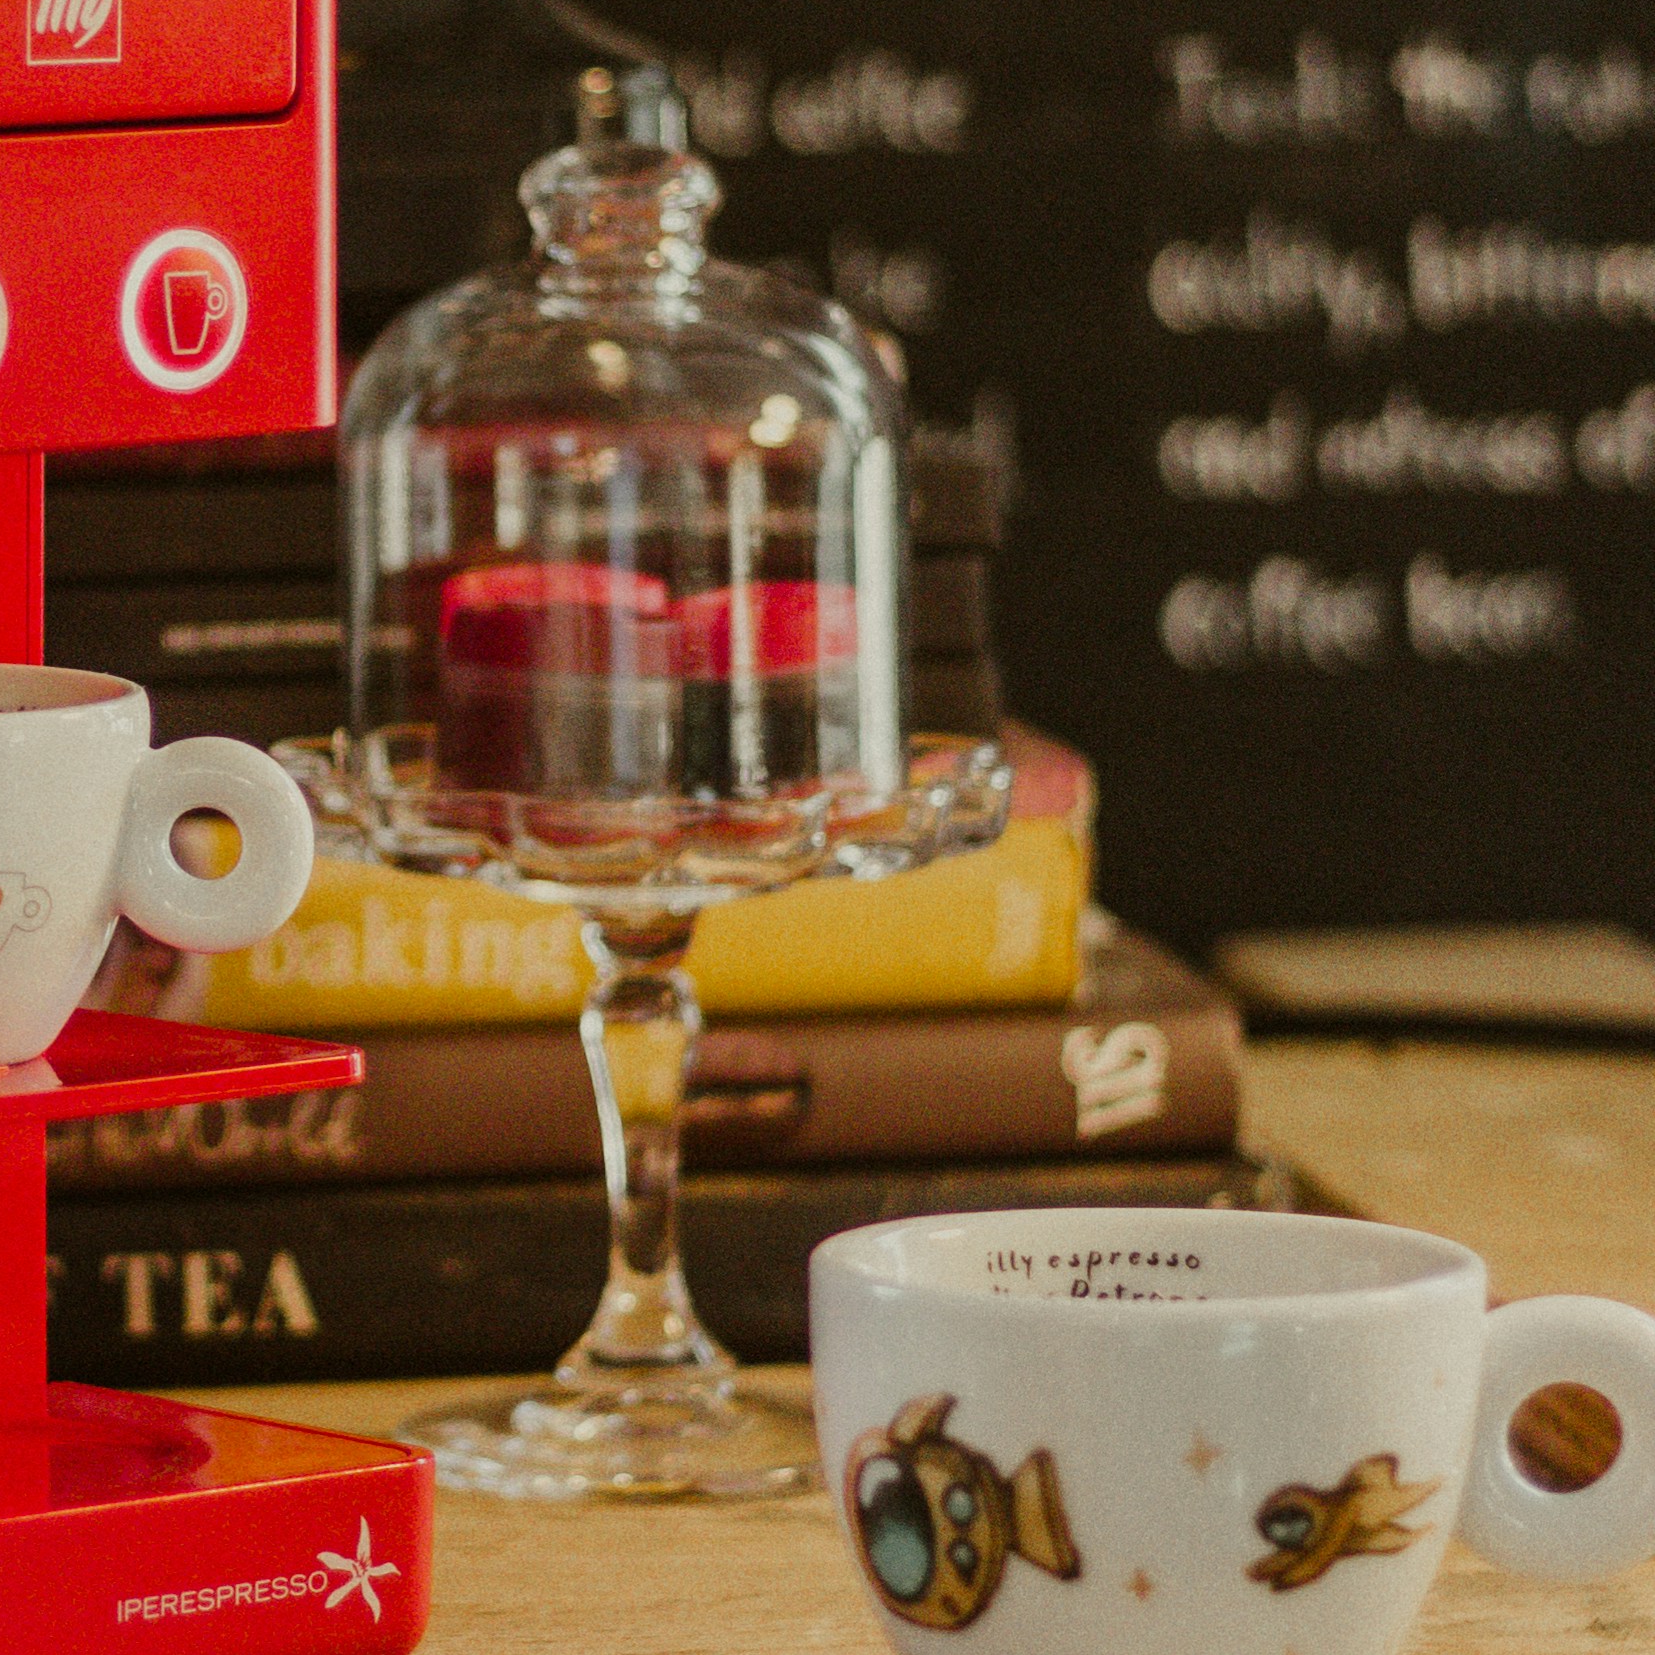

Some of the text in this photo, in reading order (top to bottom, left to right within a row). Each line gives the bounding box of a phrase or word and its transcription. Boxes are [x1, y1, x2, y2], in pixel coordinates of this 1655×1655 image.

[102, 1249, 323, 1336] TEA
[987, 1250, 1201, 1280] illy espresso
[116, 1570, 330, 1625] IPERESPRESSO
